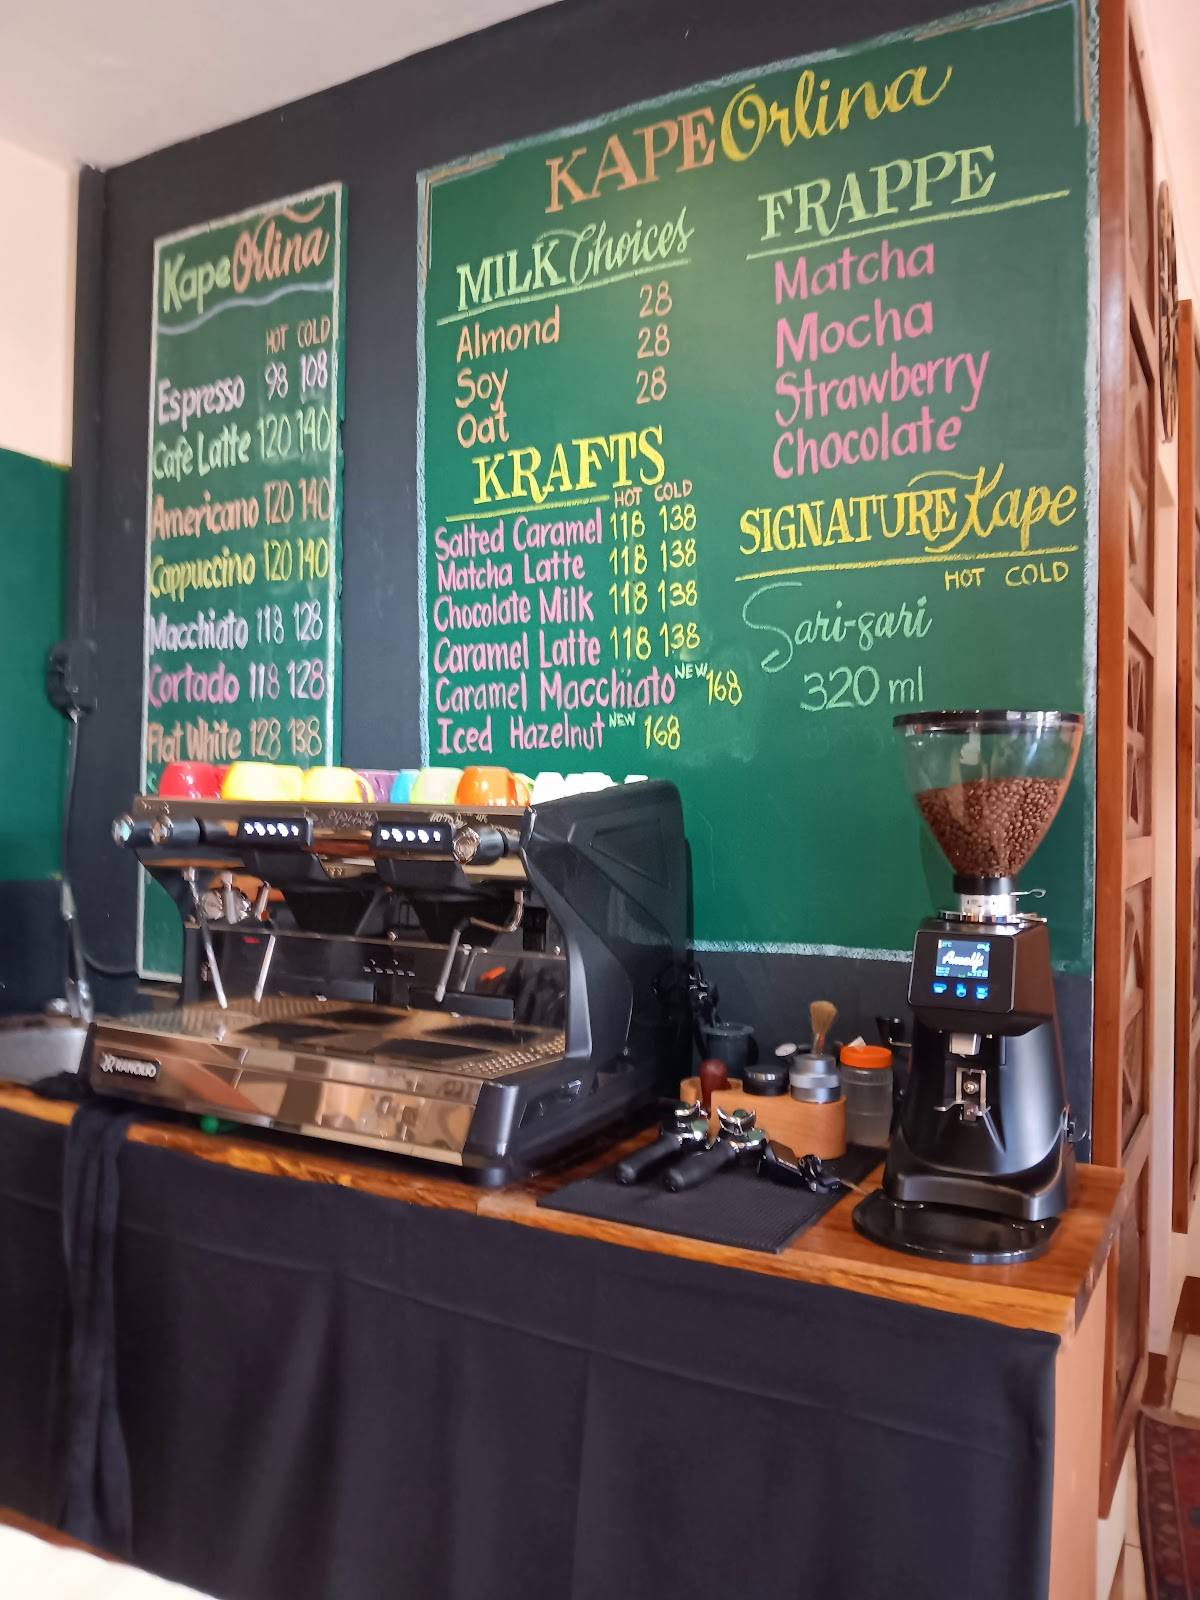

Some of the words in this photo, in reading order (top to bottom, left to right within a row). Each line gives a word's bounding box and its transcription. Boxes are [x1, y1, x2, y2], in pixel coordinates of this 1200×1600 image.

[545, 106, 717, 213] KAPE
[720, 65, 953, 162] Orlina
[758, 145, 997, 241] FRAPPE
[162, 252, 231, 315] Kape
[231, 200, 331, 294] Orlina
[456, 238, 567, 312] MILK
[564, 206, 696, 287] Choices
[774, 239, 935, 304] Matcha
[266, 324, 289, 354] HOT
[297, 315, 331, 348] COLD
[456, 304, 561, 363] Almond
[639, 281, 673, 318] 28
[776, 298, 934, 369] Mocha
[157, 374, 246, 432] Espresso
[264, 361, 289, 401] 98
[300, 347, 328, 393] 108
[455, 368, 509, 410] Soy
[637, 323, 671, 360] 28
[775, 351, 991, 428] Strawberry
[457, 401, 509, 448] Oat
[636, 366, 668, 405] 28
[197, 422, 252, 477] Latte
[257, 413, 292, 460] 120
[297, 406, 332, 452] 140
[472, 424, 666, 503] KRAFTS
[773, 406, 962, 479] Chocolate
[150, 488, 259, 542] Americano
[264, 479, 294, 525] 120
[299, 476, 332, 522] 140
[614, 488, 643, 508] HOT
[653, 479, 693, 502] COLD
[739, 487, 958, 555] SIGNATURE
[923, 462, 1078, 554] Kape
[434, 519, 505, 561] Salted
[512, 507, 603, 552] Caramel
[609, 511, 646, 541] 118
[659, 504, 697, 534] 138
[437, 558, 513, 593] Matcha
[523, 551, 586, 584] Latte
[609, 543, 648, 576] 118
[660, 538, 697, 573] 138
[149, 546, 257, 603] Cappuccino
[264, 538, 293, 582] 120
[297, 536, 329, 581] 140
[945, 568, 985, 591] HOT
[1005, 561, 1069, 588] COLD
[149, 607, 249, 656] Macchiato
[256, 603, 285, 644] 118
[294, 600, 324, 641] 128
[433, 590, 531, 632] Chocolate
[539, 585, 595, 625] Milk
[609, 580, 648, 616] 118
[658, 579, 698, 613] 138
[433, 632, 529, 674] Caramel
[539, 628, 601, 669] Latte
[610, 626, 651, 661] 118
[660, 622, 701, 658] 138
[149, 660, 241, 708] Cortado
[248, 661, 280, 703] 118
[287, 657, 325, 701] 128
[435, 671, 528, 713] Caramel
[540, 665, 676, 712] Macchiato
[674, 662, 708, 680] NEW
[706, 669, 743, 707] 168
[800, 665, 881, 712] 320
[888, 665, 925, 704] ml
[147, 720, 184, 764] Flat
[185, 715, 242, 763] White
[249, 716, 281, 760] 128
[288, 715, 323, 757] 138
[436, 715, 493, 756] Iced
[510, 712, 605, 750] Hazelnut
[608, 711, 636, 728] NEW
[644, 713, 681, 750] 168
